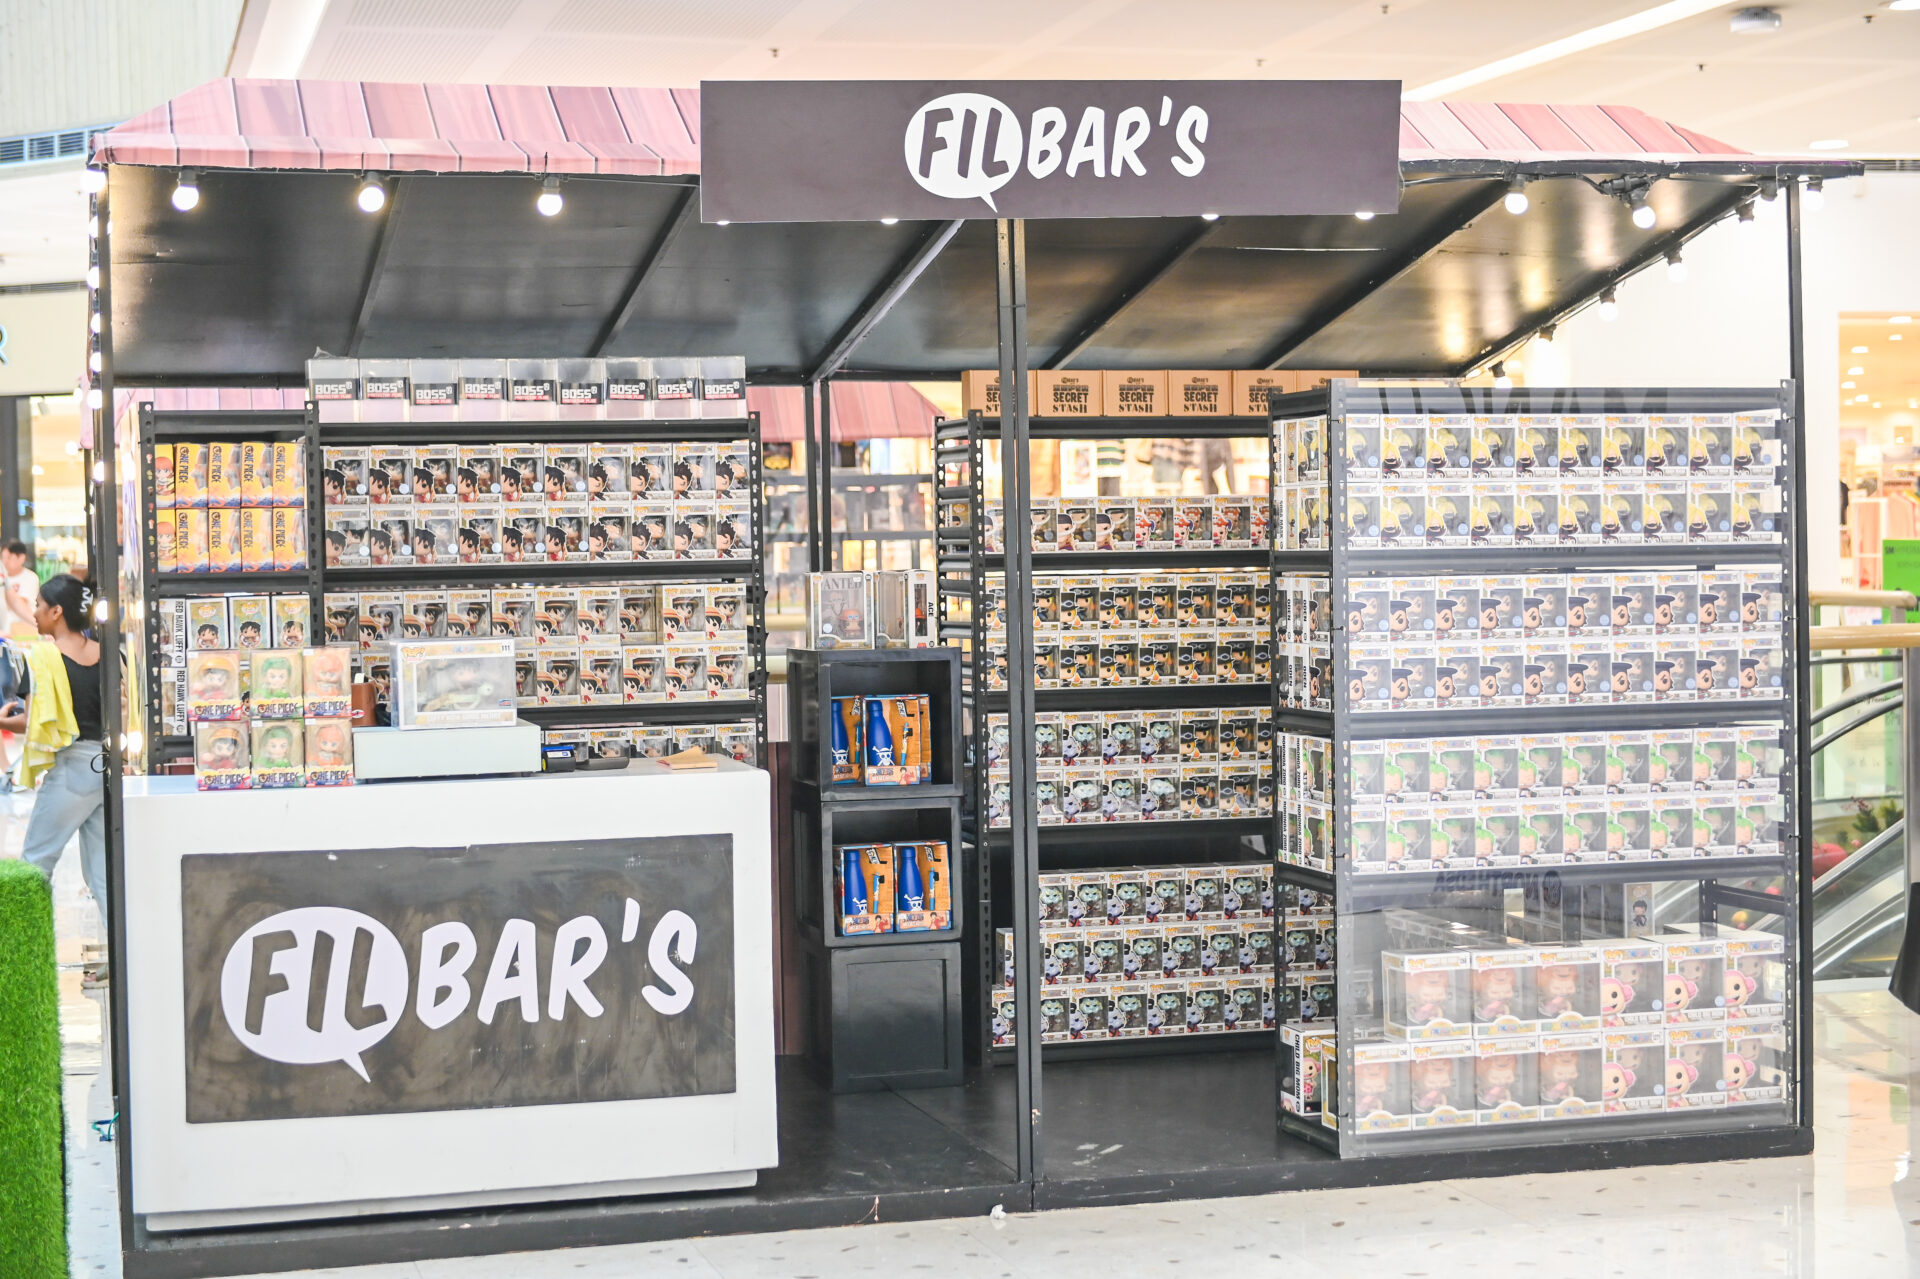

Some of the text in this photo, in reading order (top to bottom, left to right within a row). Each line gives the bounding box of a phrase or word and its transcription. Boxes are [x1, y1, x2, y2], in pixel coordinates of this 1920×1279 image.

[918, 95, 1209, 179] FILBAR'S
[315, 384, 347, 395] BOSS
[366, 382, 398, 393] BOSS
[465, 383, 495, 394] BOSS
[513, 385, 544, 396] BOSS
[609, 384, 640, 394] BOSS
[657, 384, 687, 394] BOSS
[705, 384, 735, 394] BOSS
[416, 389, 446, 399] BOSS
[562, 389, 592, 399] BOSS
[1053, 392, 1088, 403] SECRET
[1119, 392, 1154, 403] SECRET
[1184, 392, 1218, 402] SECRET
[1249, 392, 1269, 402] SEC
[1053, 404, 1087, 413] STASH
[1119, 404, 1152, 413] STASH
[1184, 403, 1217, 413] STASH
[1249, 404, 1268, 413] STA
[175, 601, 185, 653] RED HAWK LUFFY
[176, 671, 185, 723] RED HAWK LUFFY
[244, 896, 698, 1036] FILBAR'S
